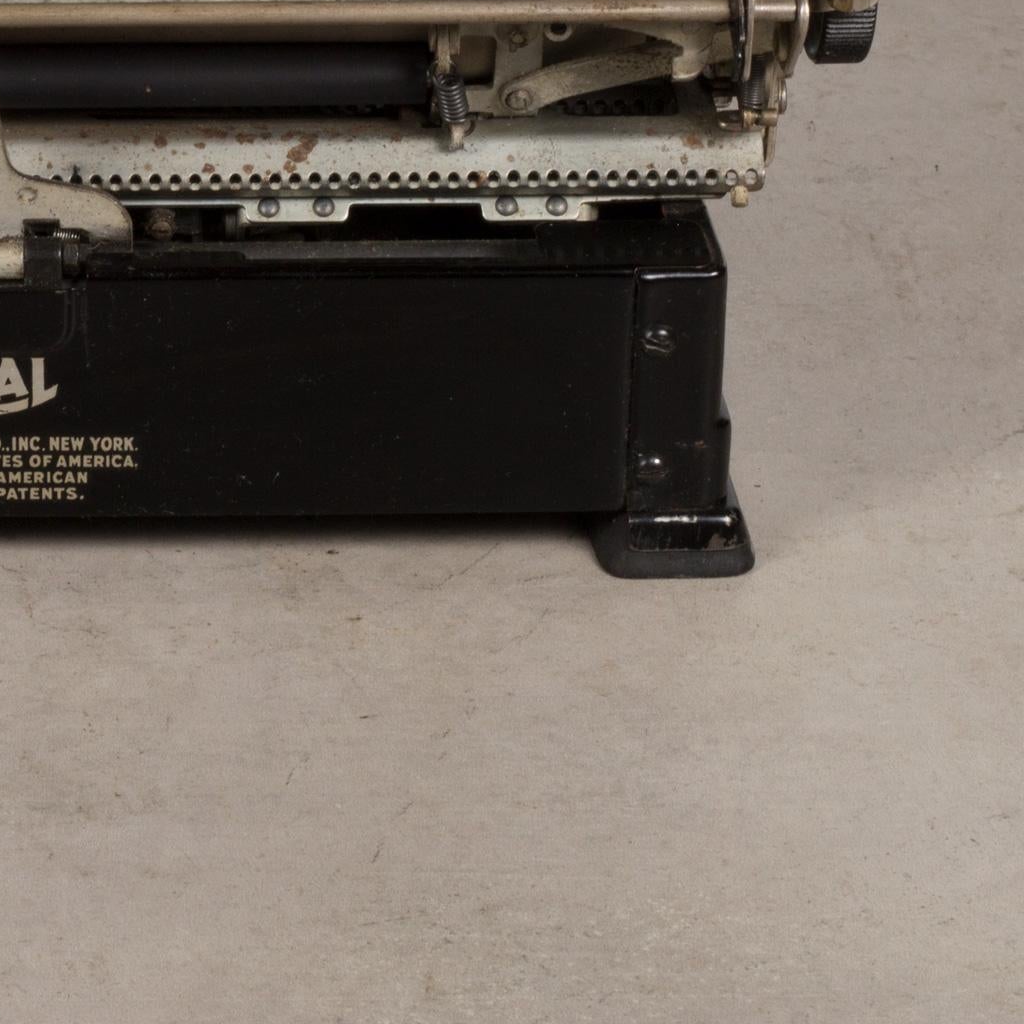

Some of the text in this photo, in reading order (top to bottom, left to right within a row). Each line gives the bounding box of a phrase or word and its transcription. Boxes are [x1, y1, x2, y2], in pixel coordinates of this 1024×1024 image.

[49, 436, 85, 452] NEW
[89, 436, 138, 452] YORK.
[28, 454, 53, 468] OF
